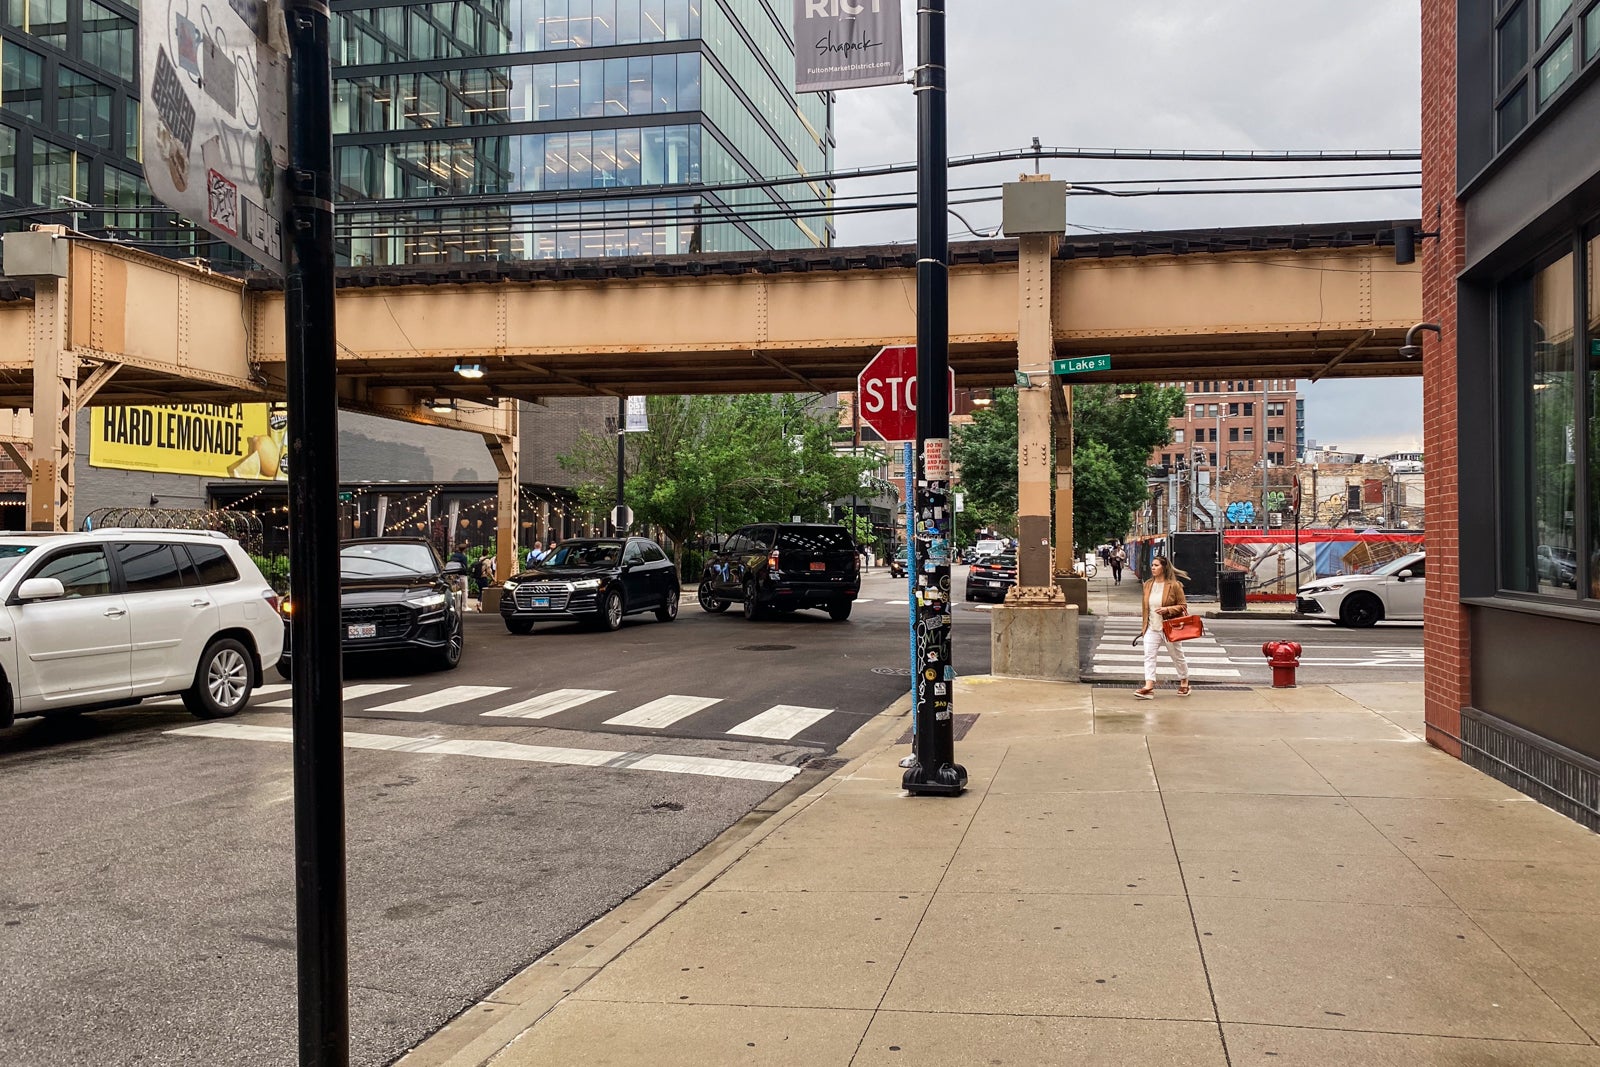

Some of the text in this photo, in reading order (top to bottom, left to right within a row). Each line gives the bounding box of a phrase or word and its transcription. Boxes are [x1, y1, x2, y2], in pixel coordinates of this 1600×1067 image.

[815, 30, 883, 58] Shapack
[807, 61, 891, 74] FultonMarketDistrict.com
[1068, 359, 1096, 372] Lake
[1097, 359, 1106, 367] St
[865, 377, 917, 412] STO
[103, 405, 243, 456] HARD LEMONADE
